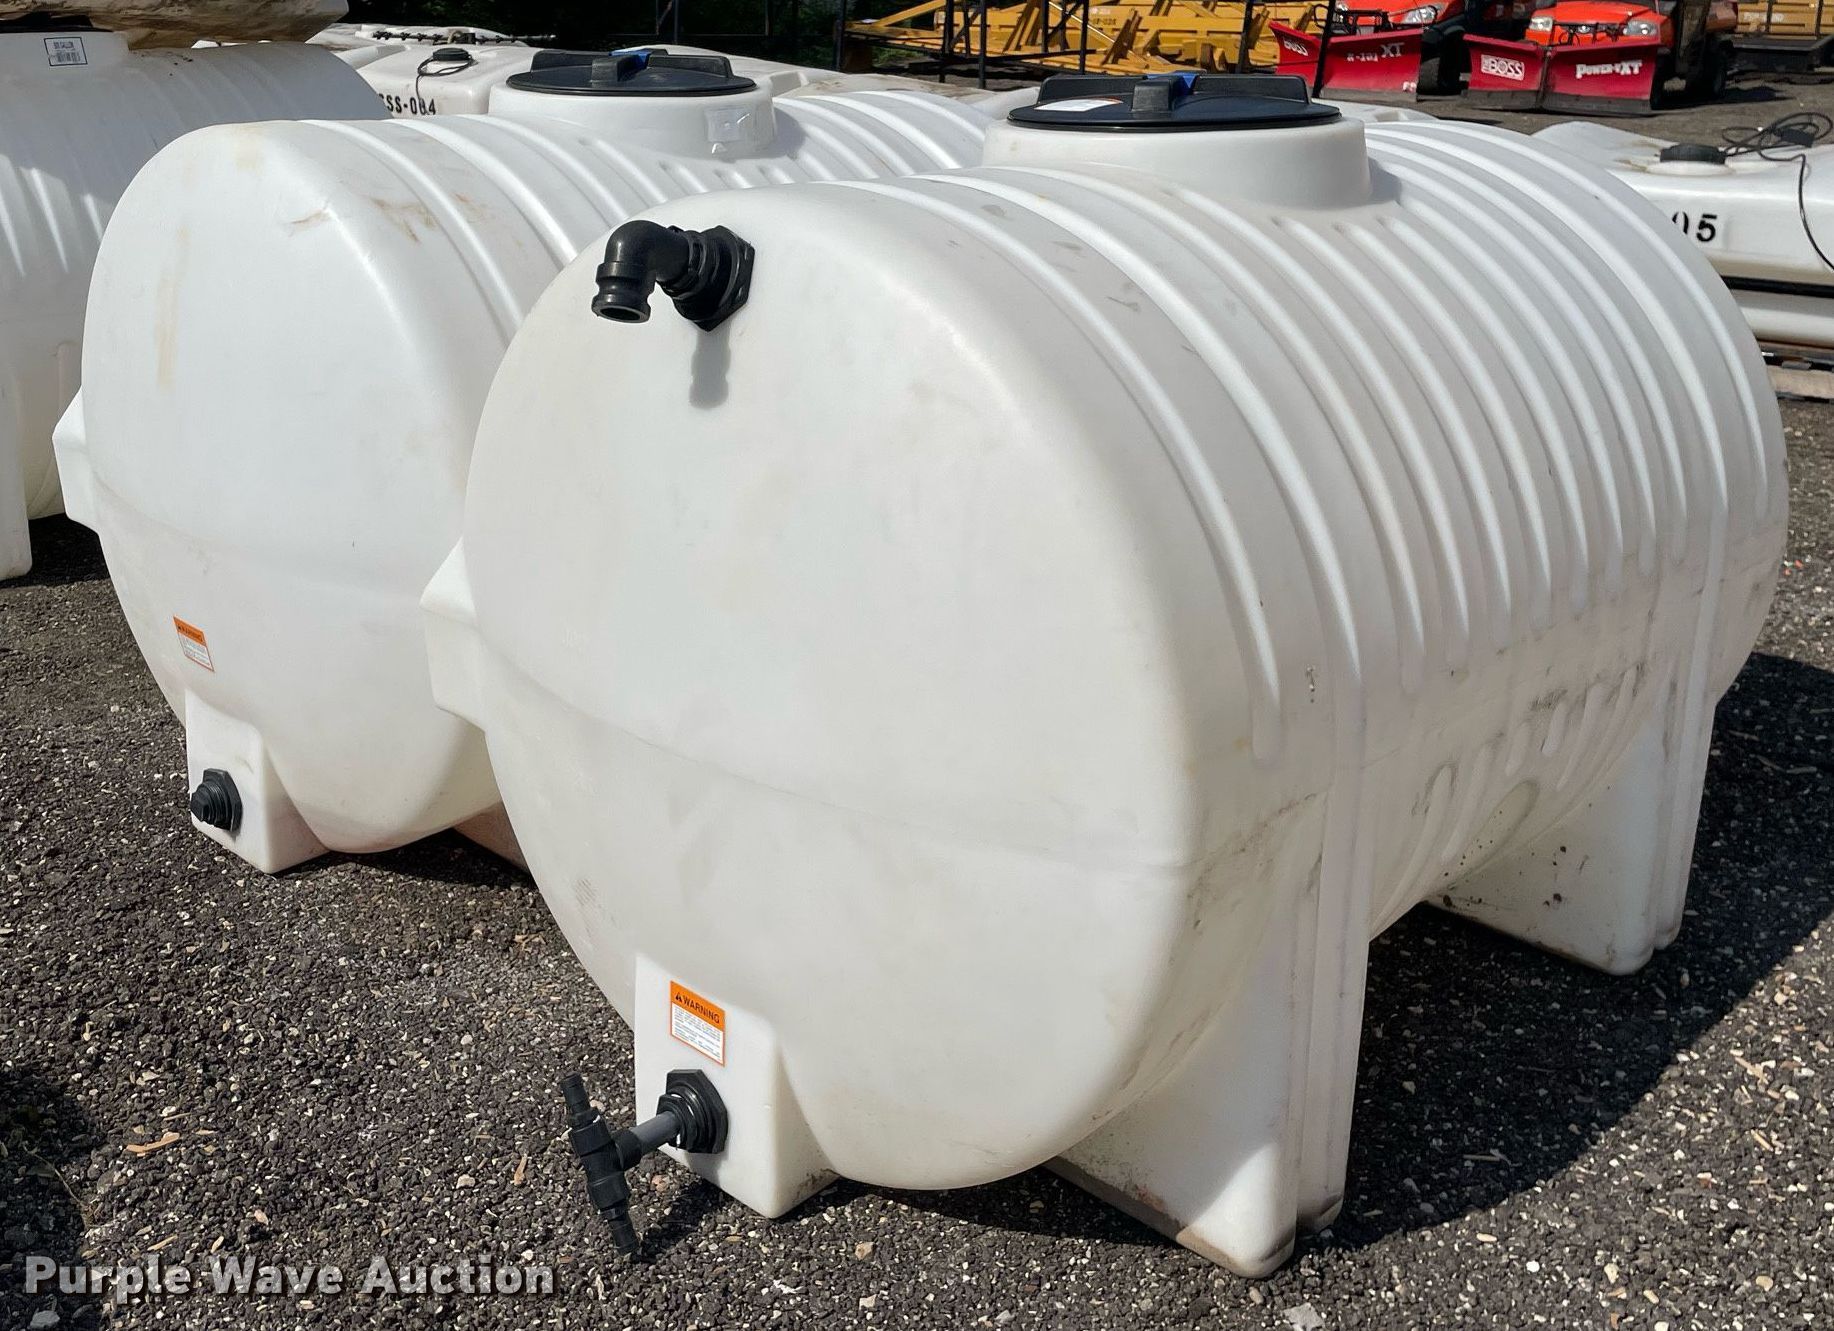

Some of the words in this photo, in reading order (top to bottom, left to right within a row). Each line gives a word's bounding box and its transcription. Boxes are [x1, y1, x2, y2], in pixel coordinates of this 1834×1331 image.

[1488, 57, 1523, 79] BOSS
[379, 93, 436, 115] SS-004
[684, 995, 720, 1024] WARNING
